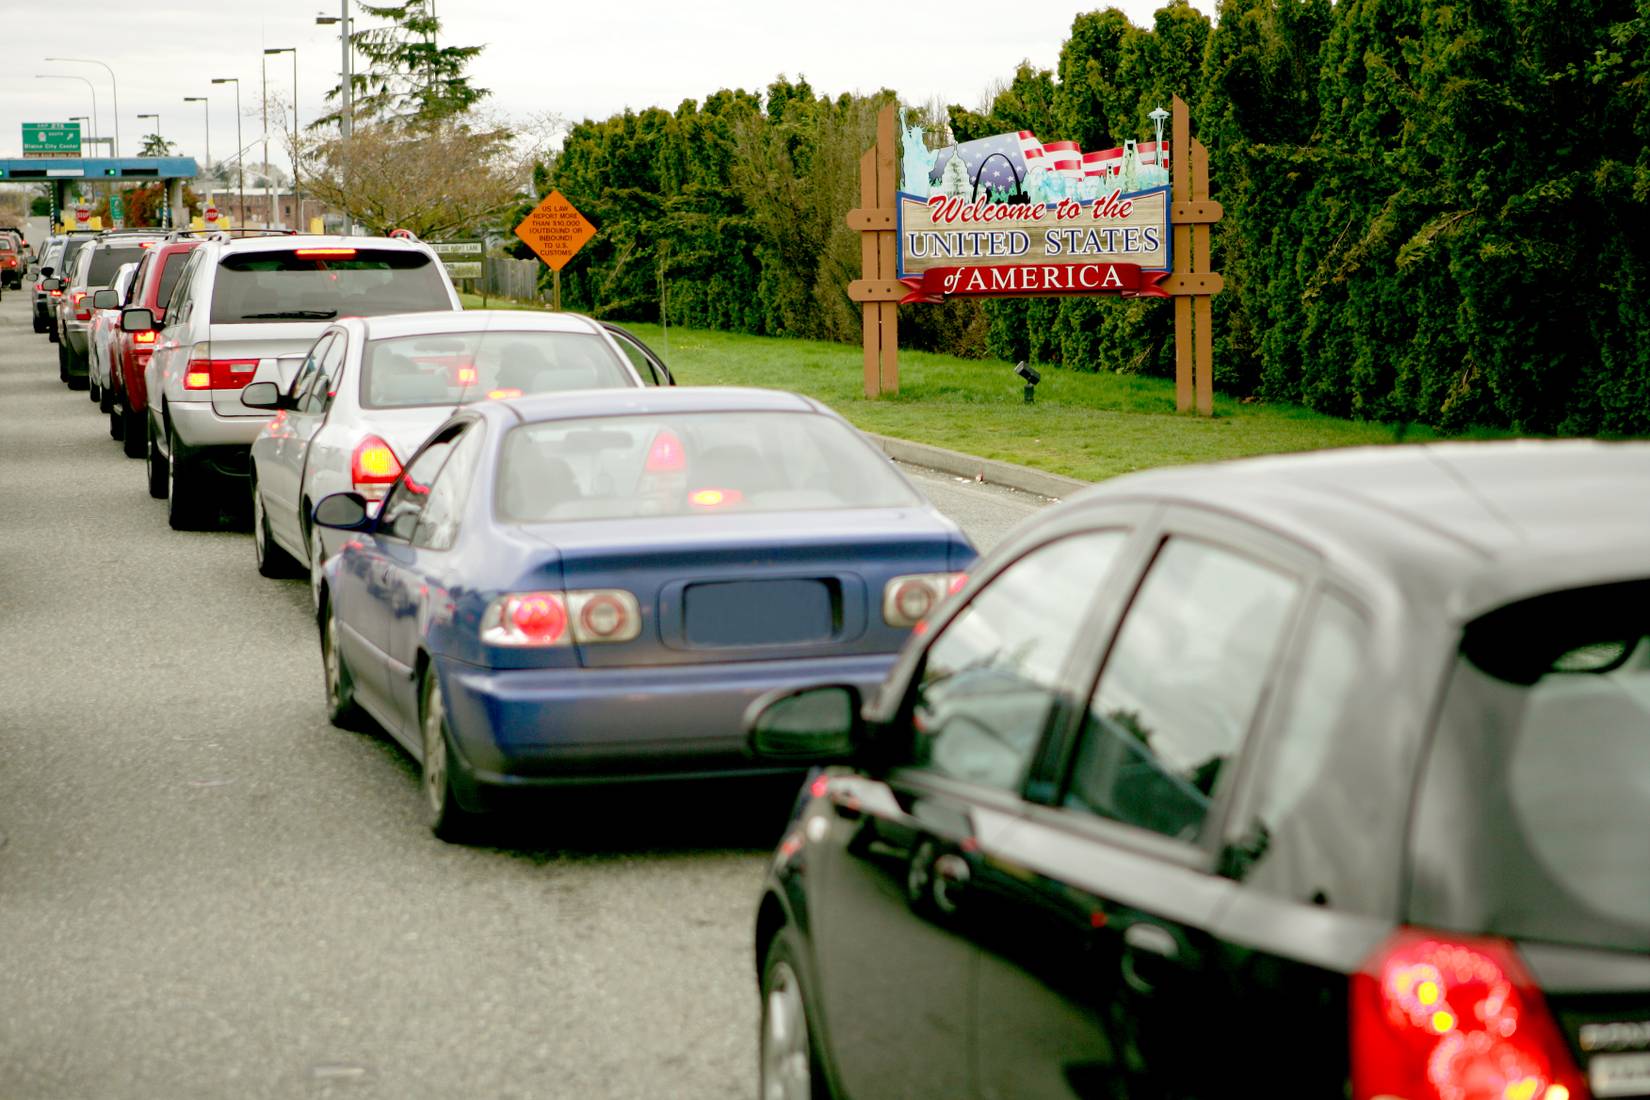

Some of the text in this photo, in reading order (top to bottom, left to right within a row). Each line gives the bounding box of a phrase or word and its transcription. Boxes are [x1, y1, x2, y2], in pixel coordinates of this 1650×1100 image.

[928, 188, 1133, 224] Welcome to the
[909, 227, 1160, 258] UNITED STATES
[944, 264, 1124, 294] of AMERICA
